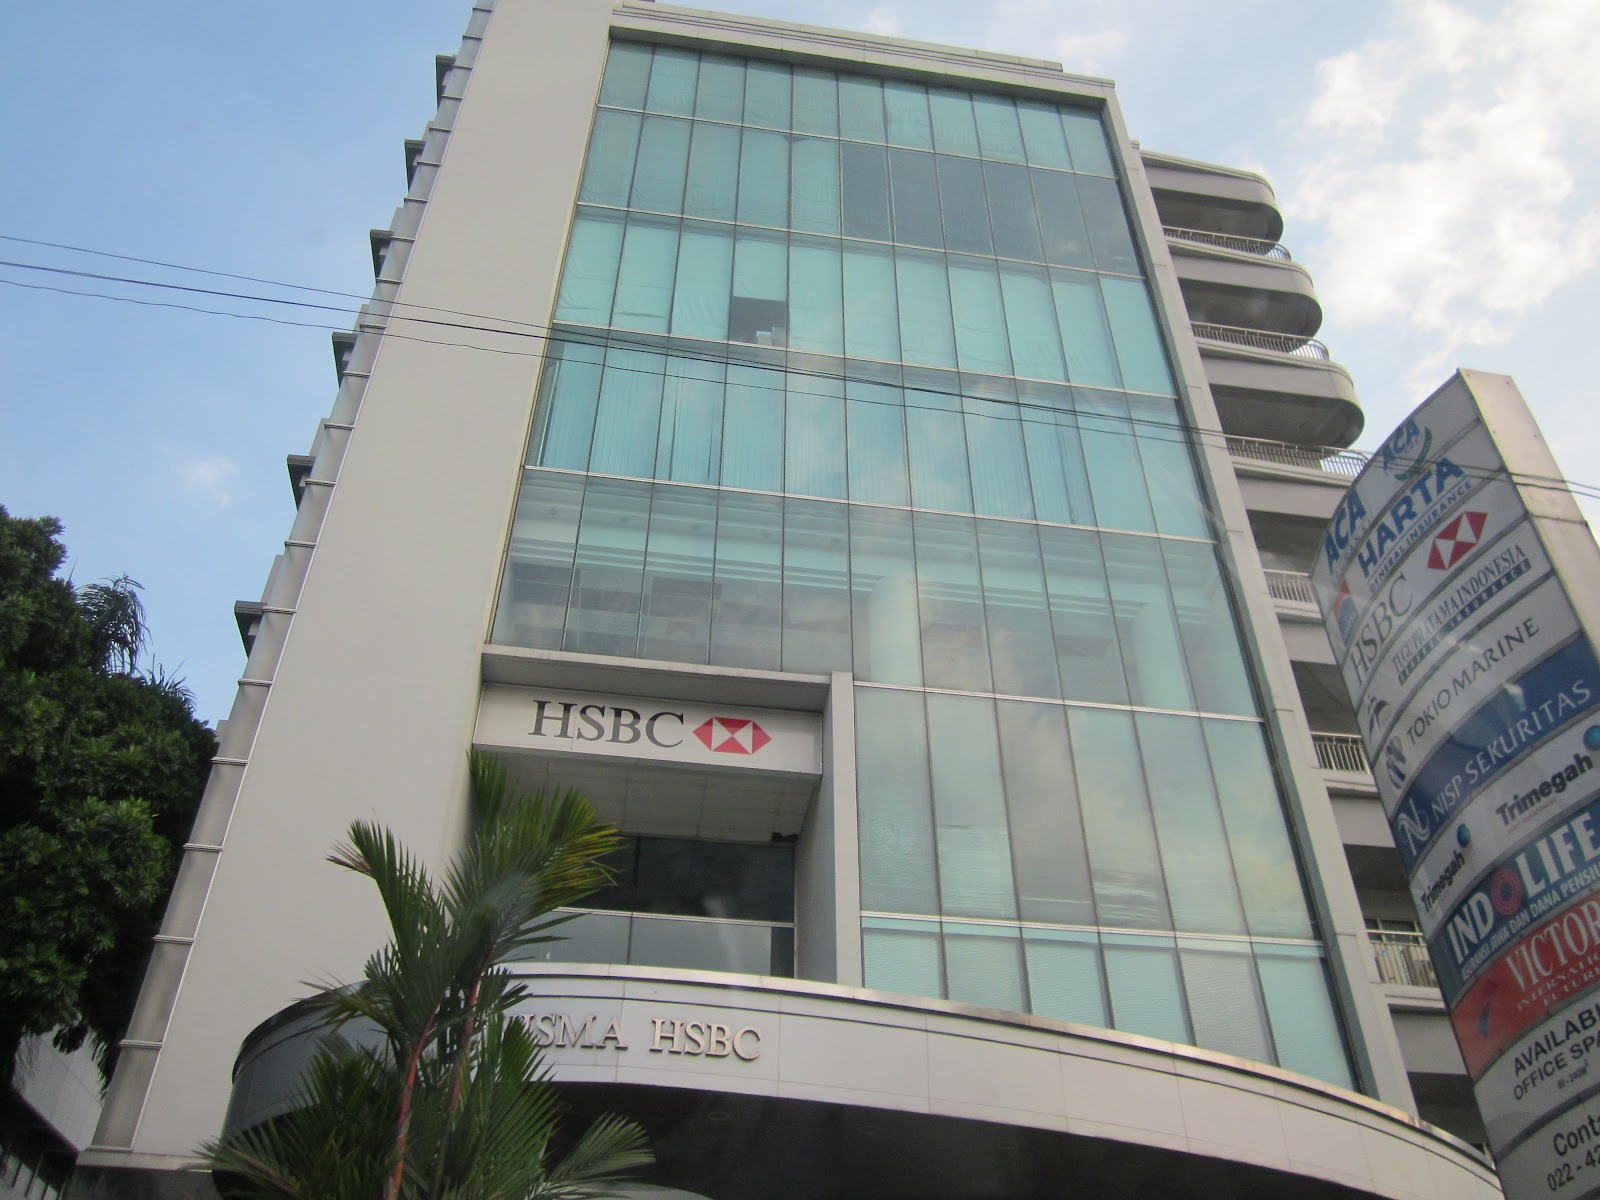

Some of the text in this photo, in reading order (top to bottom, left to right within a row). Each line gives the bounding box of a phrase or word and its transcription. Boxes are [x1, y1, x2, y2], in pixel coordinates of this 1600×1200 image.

[1383, 418, 1420, 477] ACA
[1325, 488, 1366, 577] ACA
[1358, 457, 1465, 578] HARTA
[1369, 480, 1473, 593] GENERAL INSURANCE
[1456, 544, 1527, 605] INDONESIA
[1350, 573, 1413, 686] HSBC
[1406, 617, 1540, 745] TOKIO MARINE
[528, 699, 684, 749] HSBC
[1431, 774, 1462, 823] NISP
[1465, 679, 1591, 784] SEKURITAS
[1496, 752, 1594, 827] Trimegah
[1421, 850, 1465, 913] Trimegah
[1509, 909, 1531, 933] DAN
[1530, 889, 1561, 917] DANA
[650, 1018, 762, 1061] HSBC
[1513, 1052, 1568, 1100] OFFICE
[1547, 1162, 1575, 1192] 022
